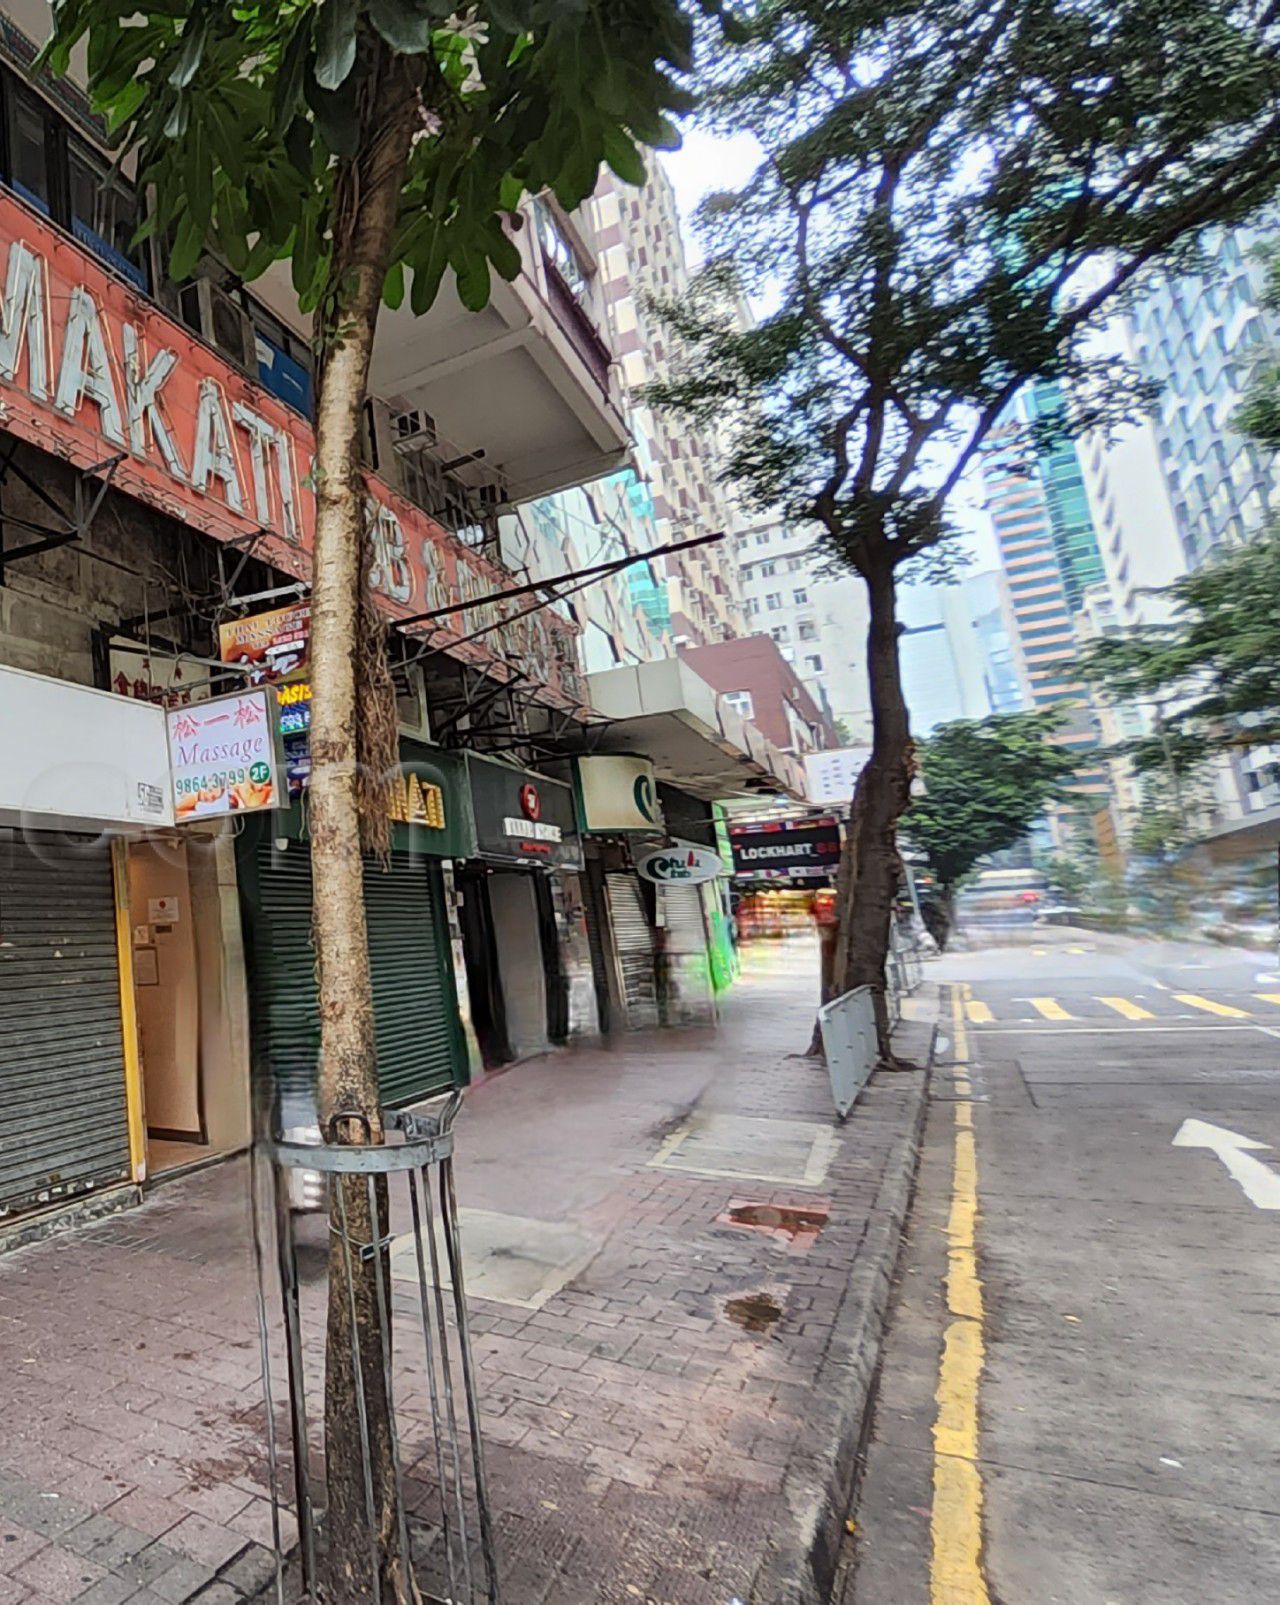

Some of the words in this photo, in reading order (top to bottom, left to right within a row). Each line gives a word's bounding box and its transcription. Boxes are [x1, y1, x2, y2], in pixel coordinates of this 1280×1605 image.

[172, 698, 266, 743] 松一松
[176, 734, 265, 768] Massage
[251, 764, 268, 783] 2F
